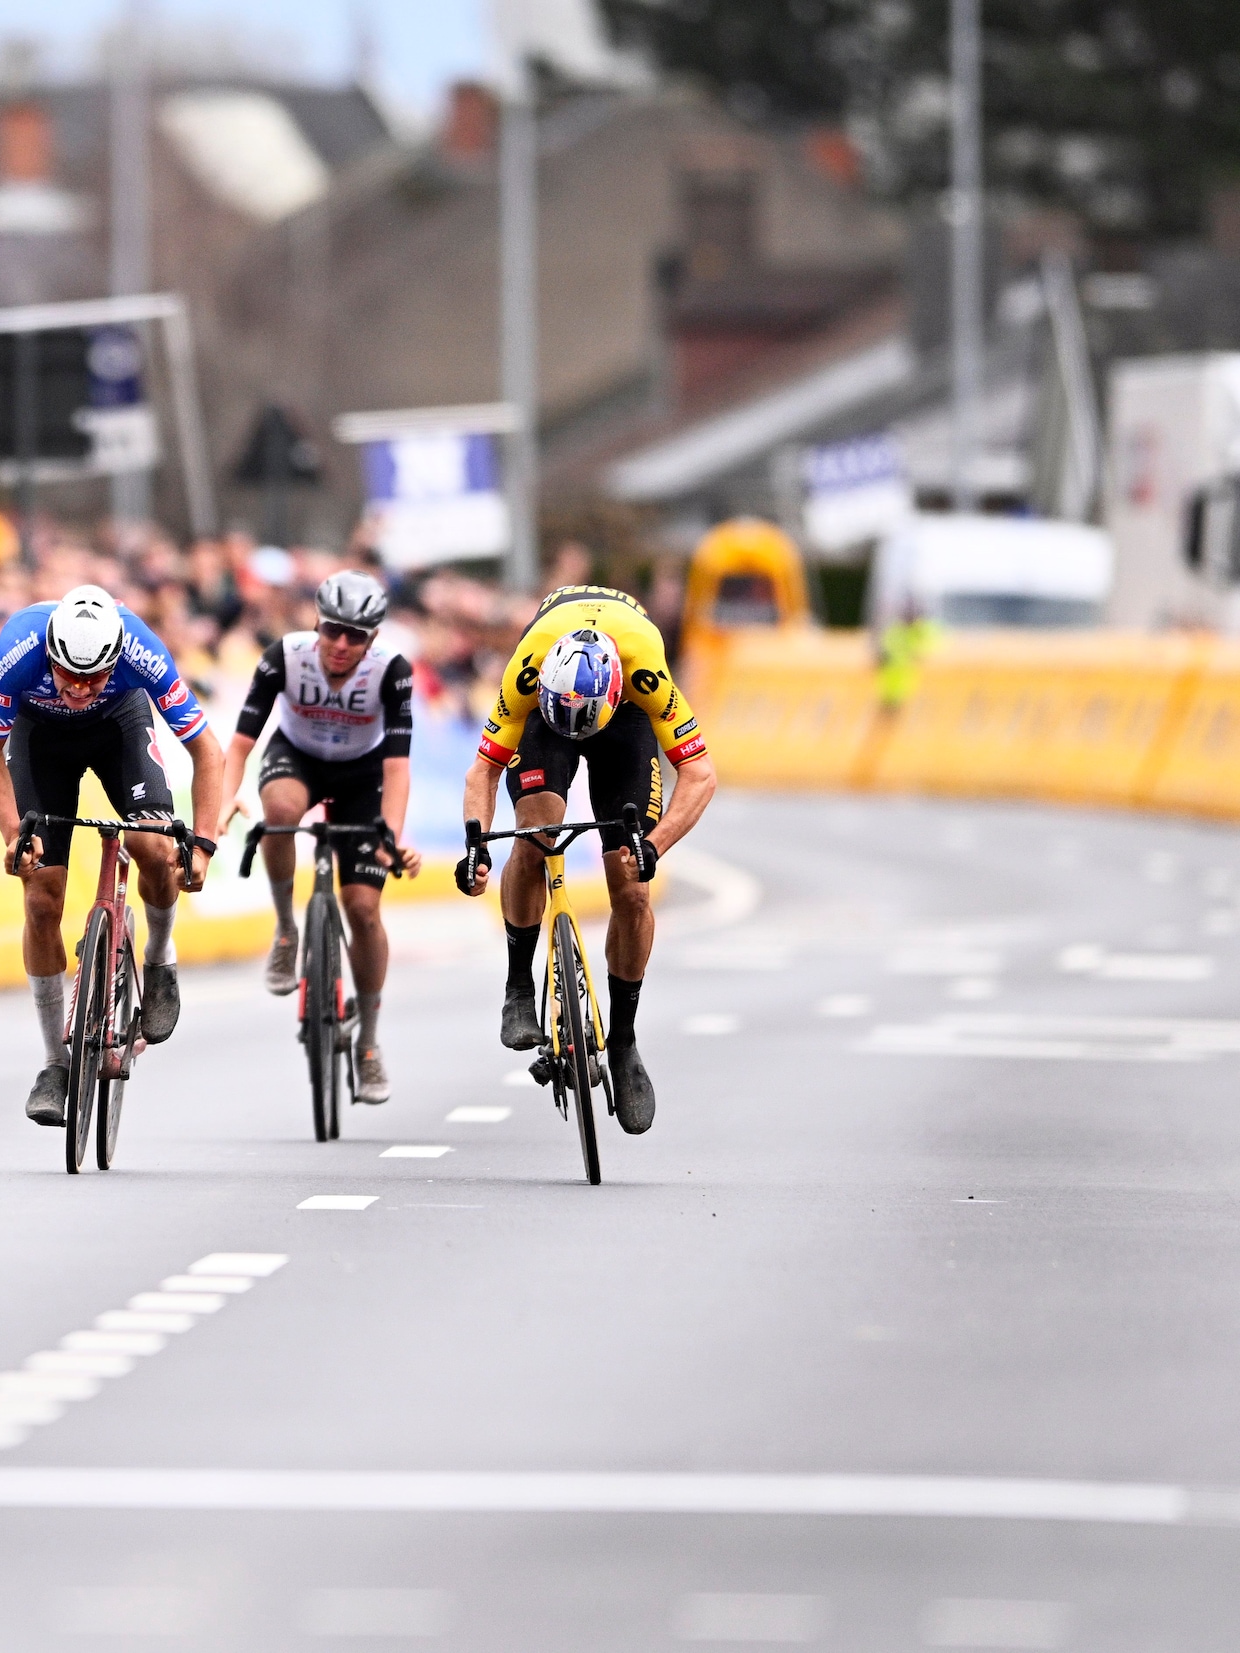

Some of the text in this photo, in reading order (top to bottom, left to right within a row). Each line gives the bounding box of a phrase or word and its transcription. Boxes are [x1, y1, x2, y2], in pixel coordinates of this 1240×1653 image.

[123, 632, 168, 681] Alpecin
[300, 682, 368, 713] UAE
[521, 773, 543, 784] HEMA
[646, 757, 662, 824] JUMBO
